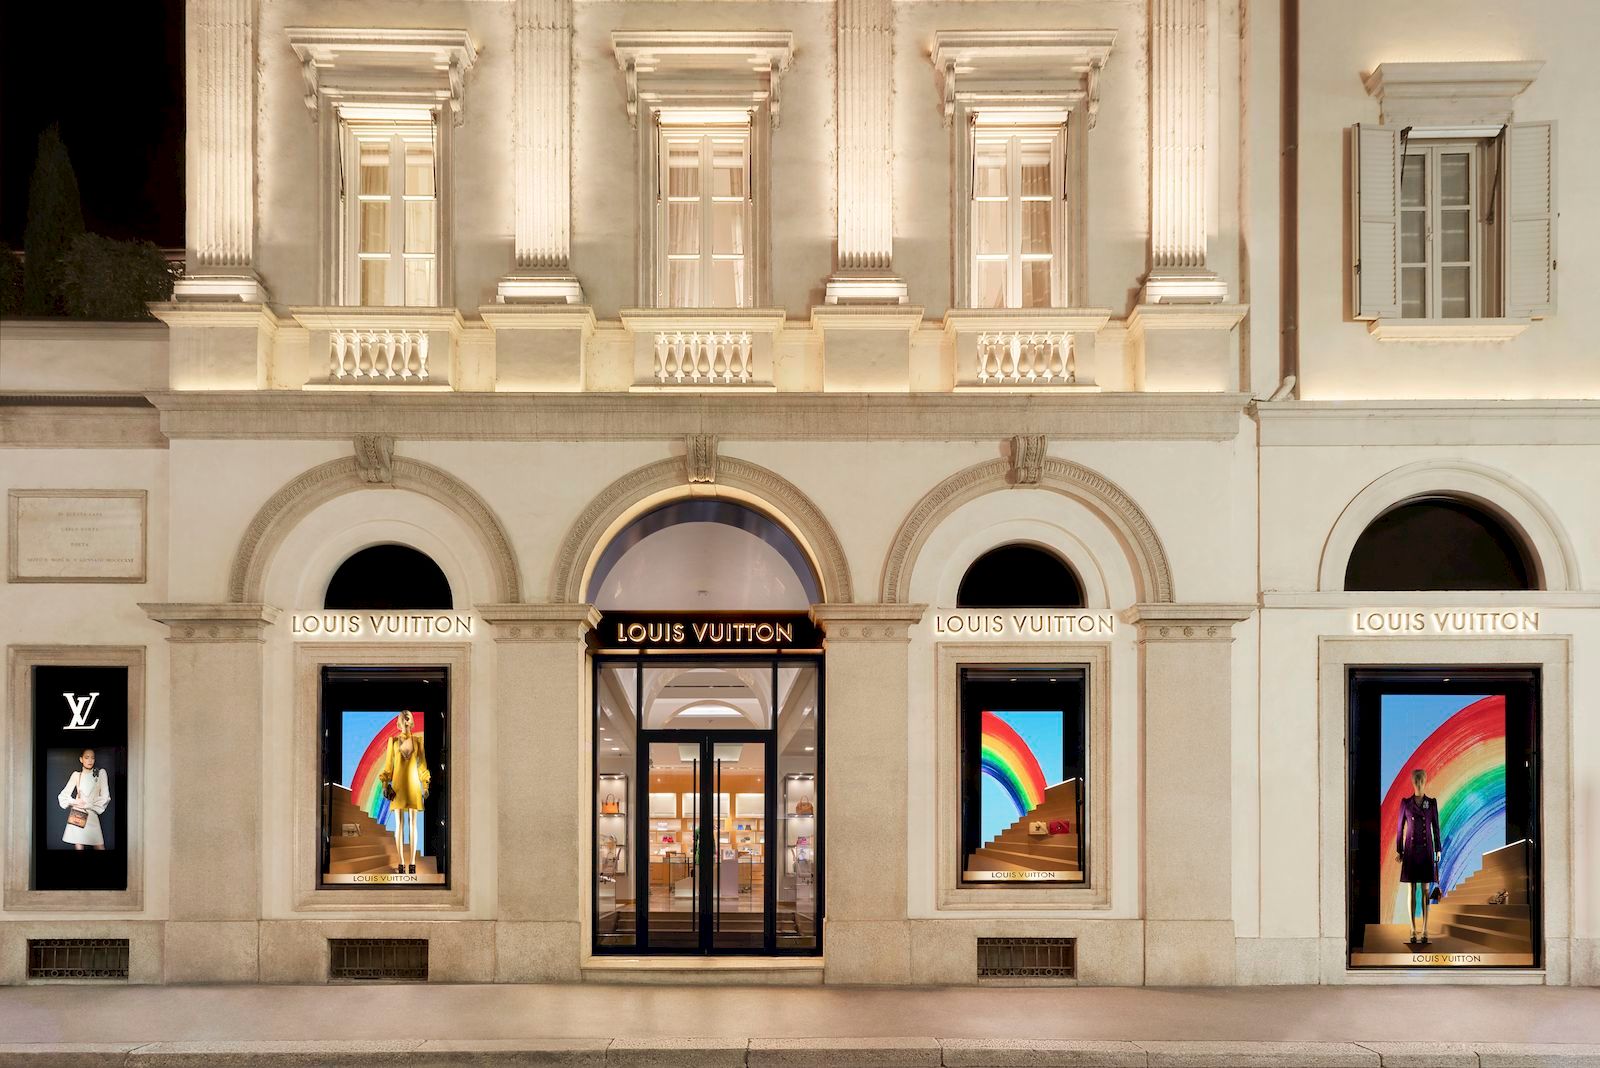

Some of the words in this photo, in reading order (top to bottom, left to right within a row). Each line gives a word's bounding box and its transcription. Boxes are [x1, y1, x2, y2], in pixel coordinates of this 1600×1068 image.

[292, 615, 360, 633] LOUIS
[369, 615, 472, 634] VUITTON
[937, 615, 1003, 633] LOUIS
[1013, 615, 1114, 633] VUITTON
[1356, 613, 1425, 631] LOUIS
[1433, 612, 1540, 631] VUITTON
[617, 622, 685, 642] LOUIS
[692, 622, 793, 643] VUITTON
[62, 692, 100, 730] LV
